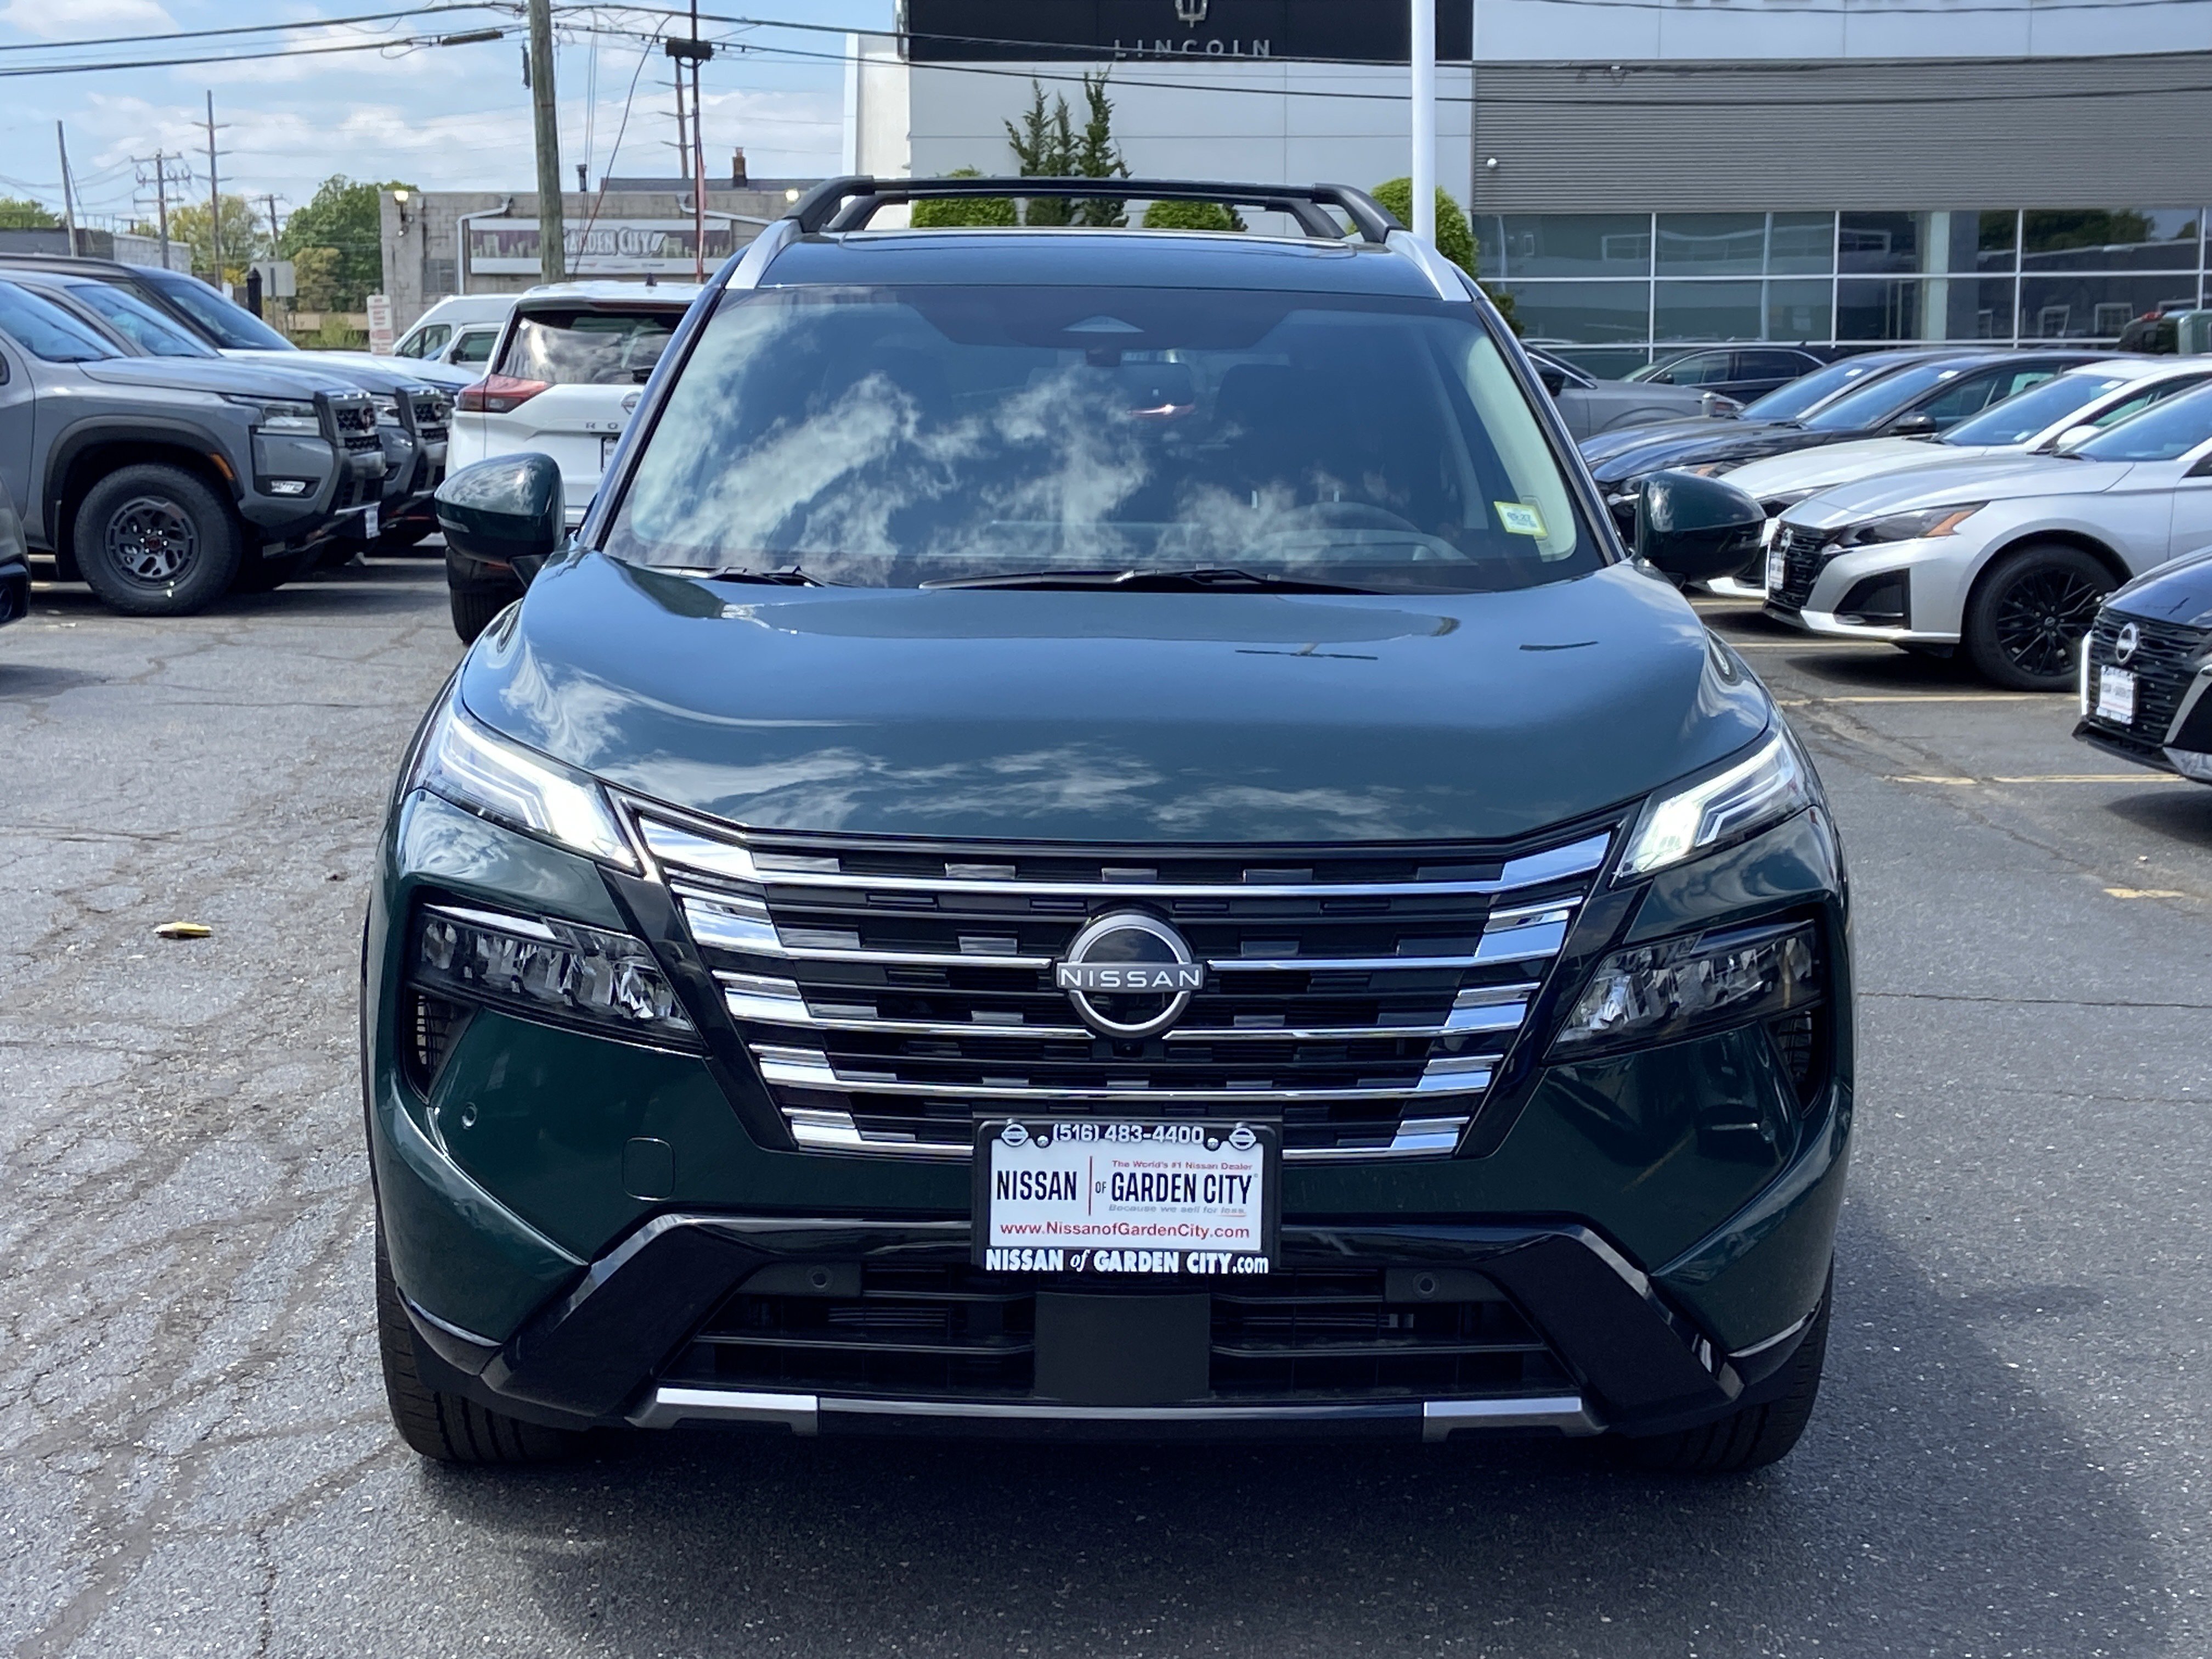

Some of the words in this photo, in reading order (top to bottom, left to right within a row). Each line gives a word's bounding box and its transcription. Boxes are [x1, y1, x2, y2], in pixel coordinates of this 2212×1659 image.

[1114, 40, 1270, 58] LINCOLN
[563, 228, 618, 256] ARDEN
[1060, 969, 1199, 988] NISSAN
[1052, 1124, 1099, 1142] (516)
[1104, 1125, 1205, 1144] 483-4400
[1113, 1160, 1130, 1168] The
[1133, 1160, 1169, 1169] World's
[1185, 1161, 1218, 1170] Nissan
[1221, 1162, 1252, 1170] Dealer
[997, 1170, 1077, 1200] NISSAN
[1094, 1181, 1107, 1194] OF
[1111, 1172, 1197, 1203] GARDEN
[1203, 1174, 1252, 1205] CITY
[1109, 1204, 1156, 1212] Because
[1181, 1205, 1200, 1214] sell
[1203, 1205, 1218, 1214] for
[1000, 1221, 1250, 1240] www.NissanofGardenCity.com
[986, 1249, 1064, 1272] NISSAN
[1070, 1249, 1091, 1272] of
[1093, 1250, 1180, 1273] GARDEN
[1187, 1251, 1269, 1274] CITY.com
